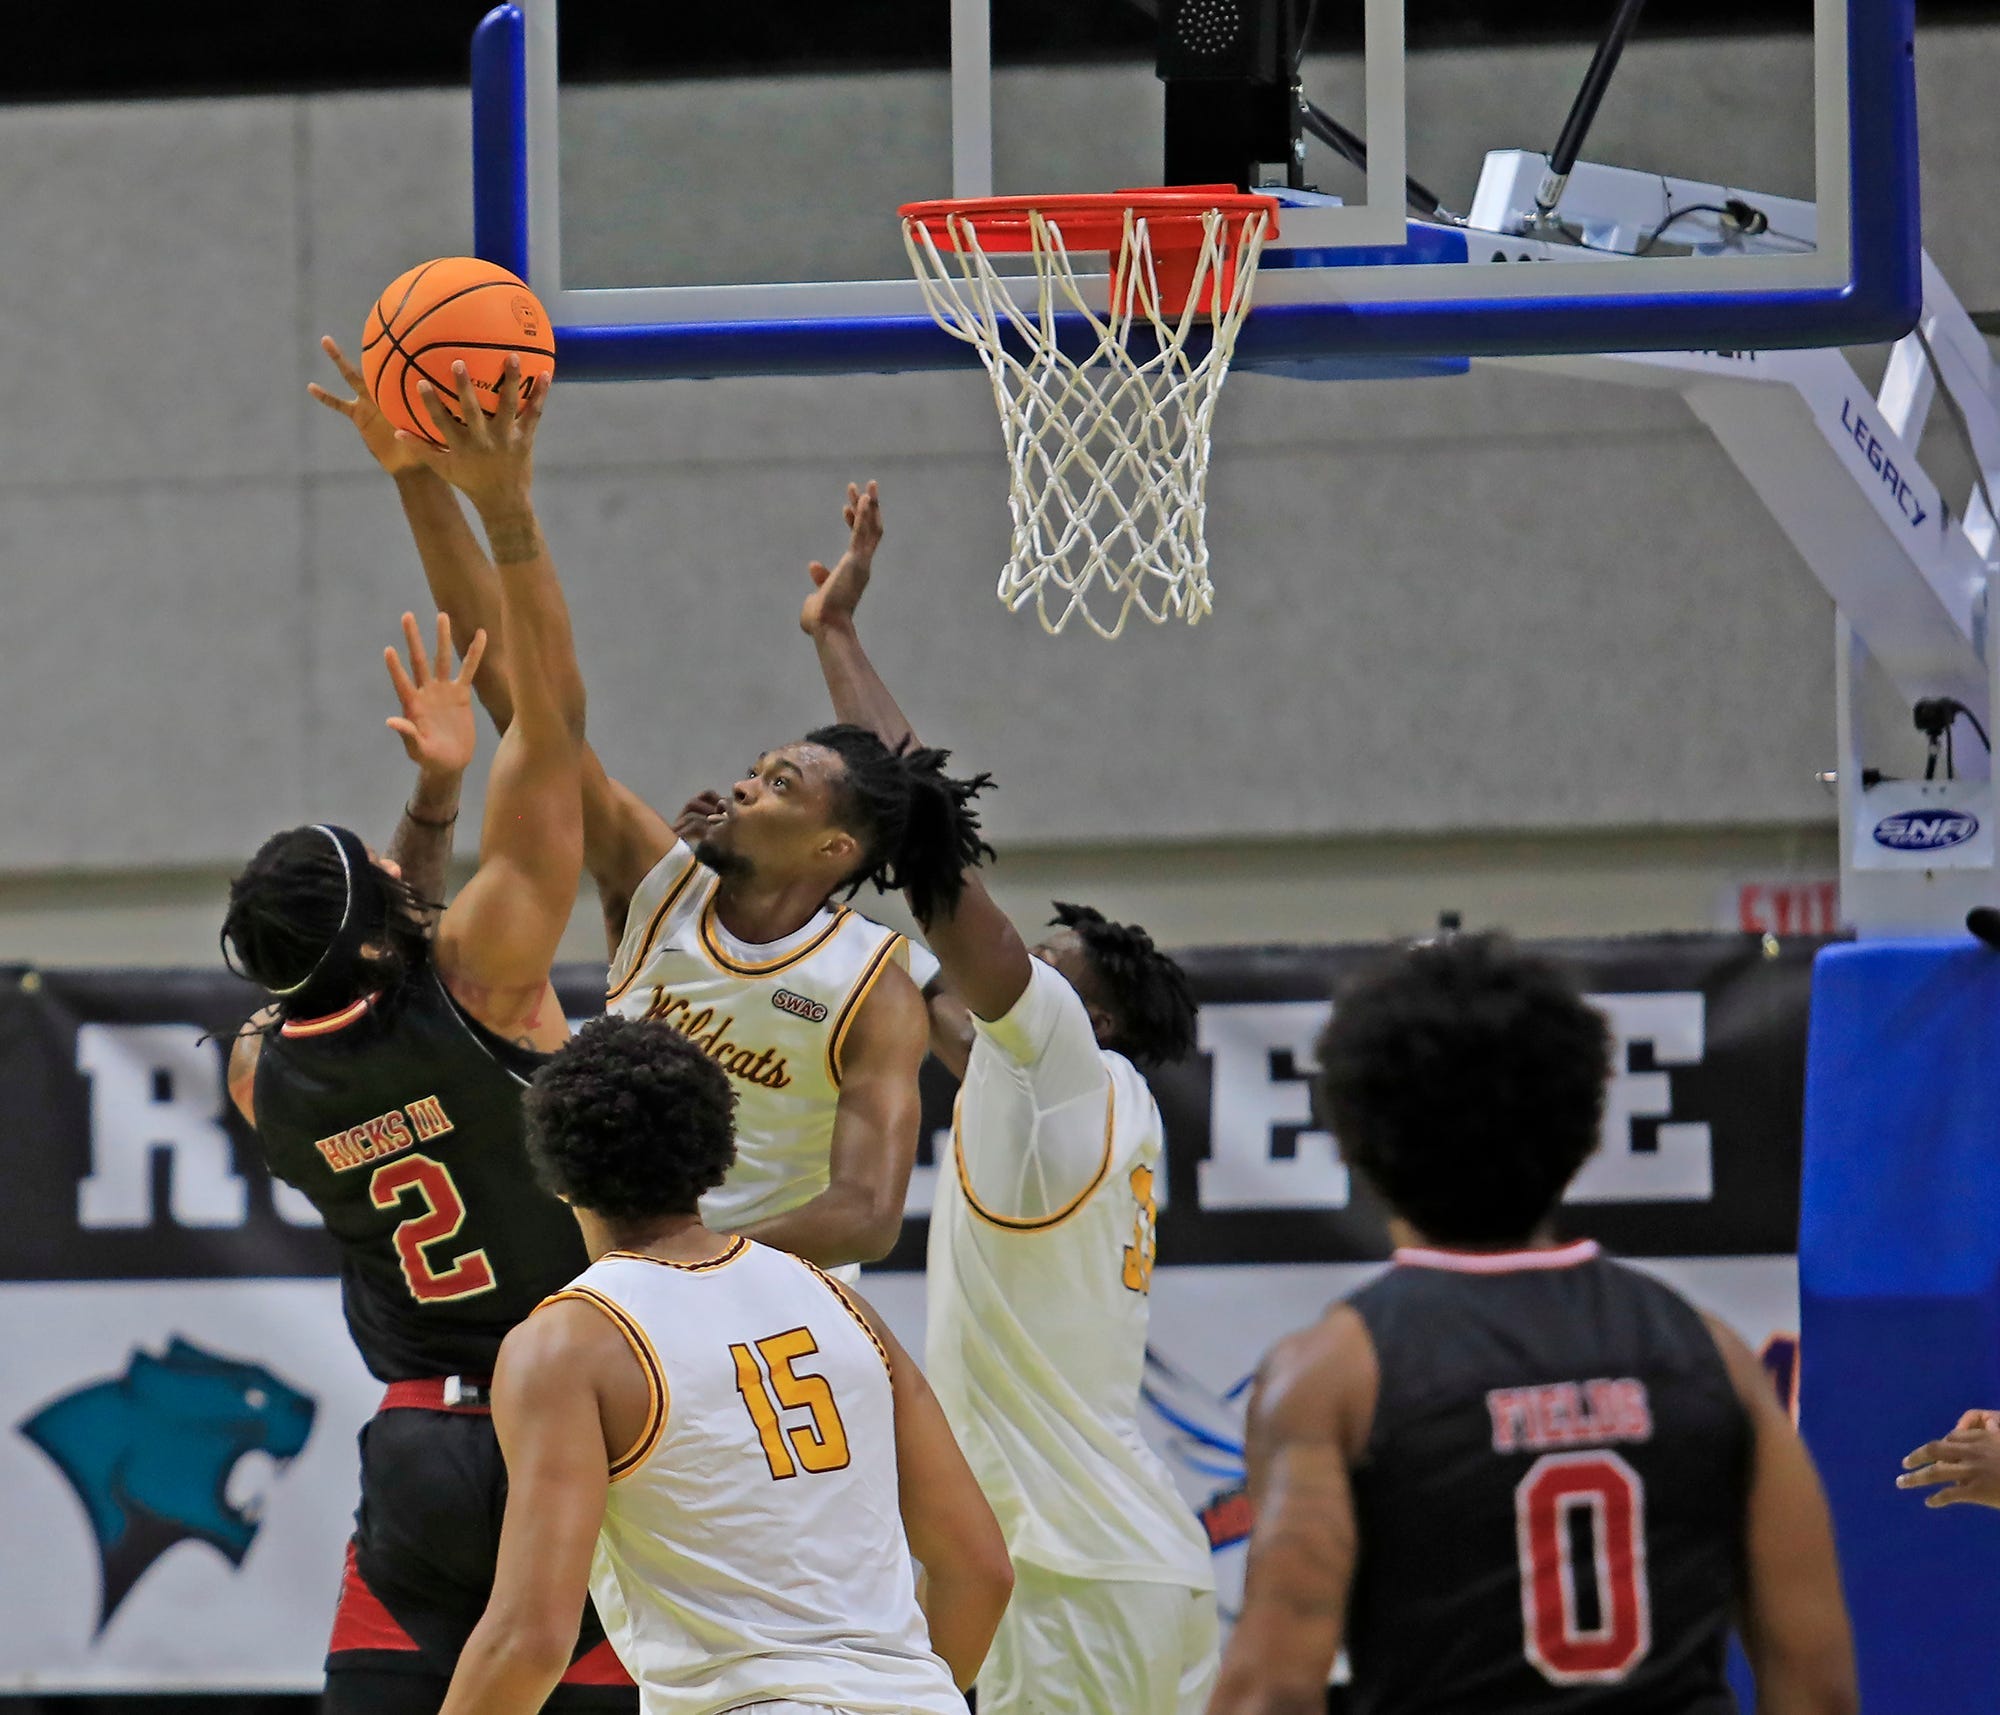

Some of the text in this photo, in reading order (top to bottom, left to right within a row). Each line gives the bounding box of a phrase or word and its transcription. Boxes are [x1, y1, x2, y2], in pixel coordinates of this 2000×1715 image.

[1841, 397, 1927, 527] LEGACY
[642, 984, 792, 1089] Wildcats
[772, 988, 828, 1023] SWAC
[315, 1094, 455, 1173] HICKS III
[368, 1152, 498, 1305] 2
[728, 1325, 851, 1481] 15
[1514, 1449, 1652, 1687] 0
